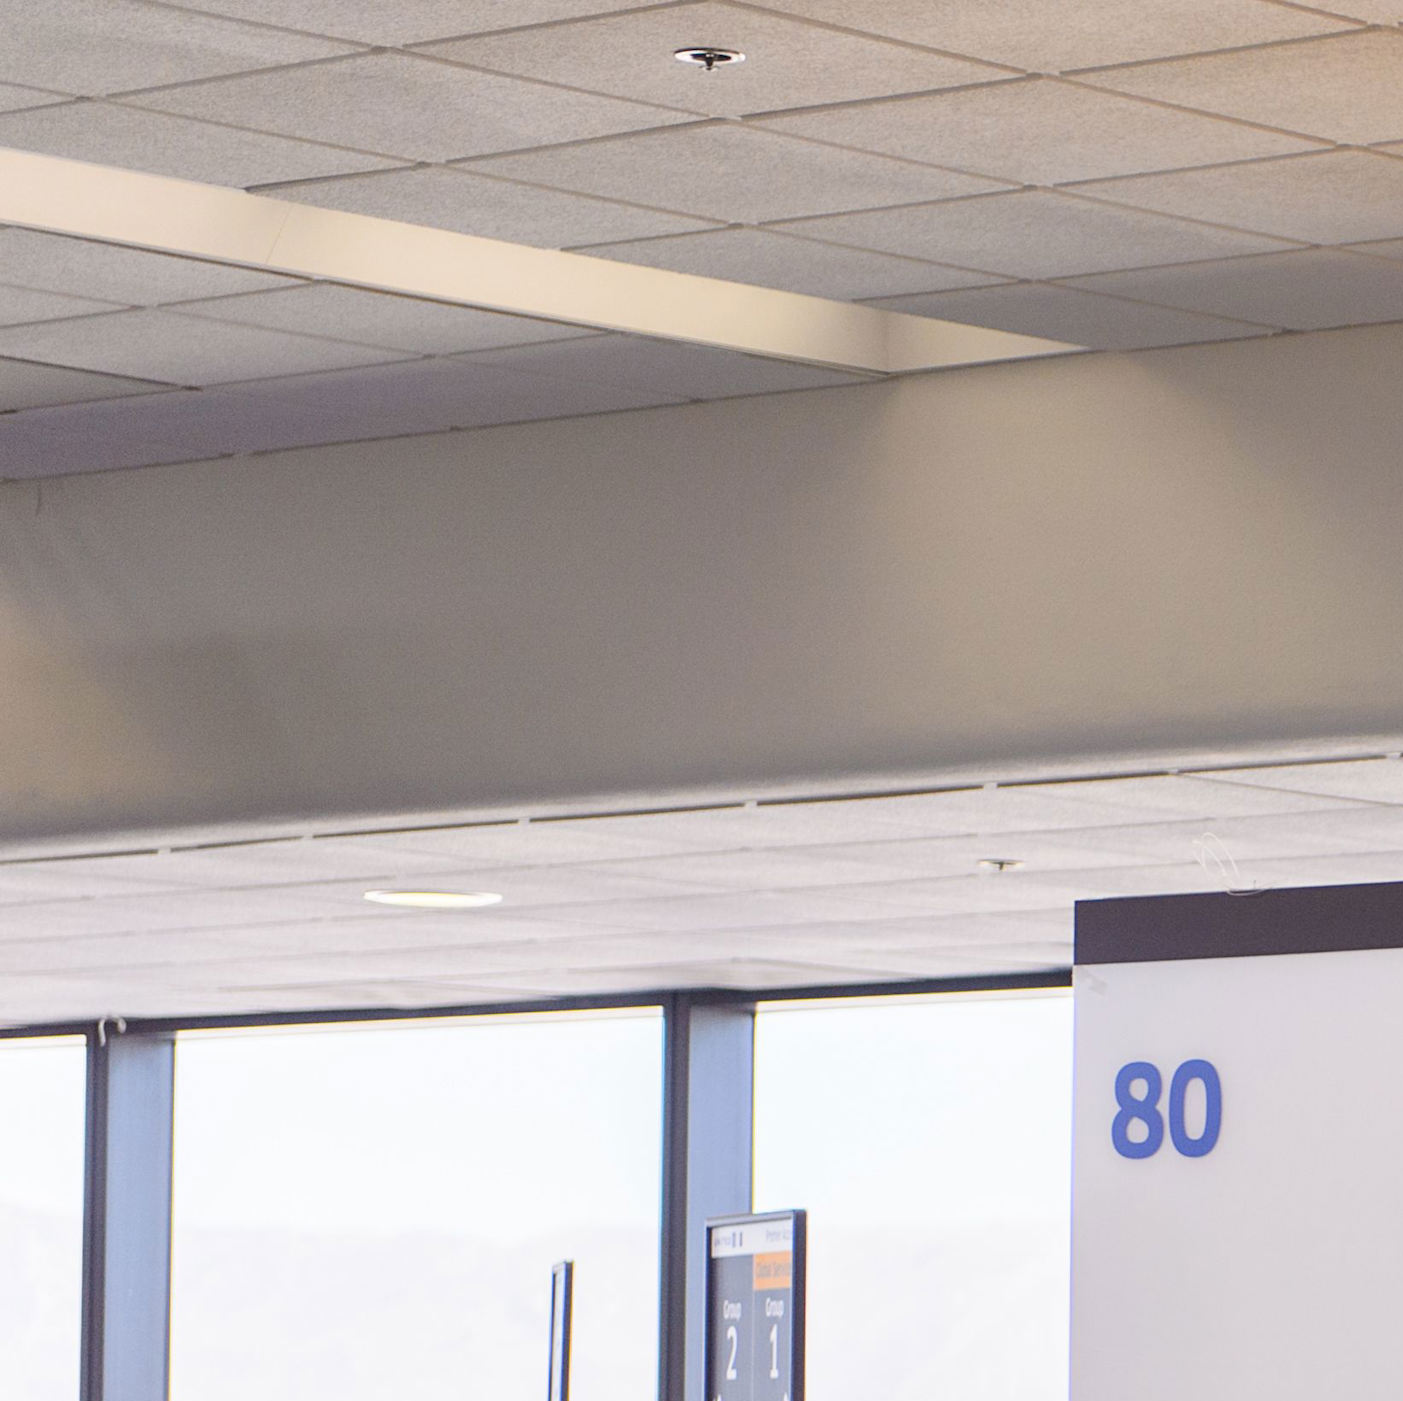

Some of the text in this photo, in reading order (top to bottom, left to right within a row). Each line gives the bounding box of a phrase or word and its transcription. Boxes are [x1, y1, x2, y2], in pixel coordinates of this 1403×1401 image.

[1111, 1058, 1222, 1159] 80
[723, 1300, 742, 1320] Group
[765, 1297, 784, 1319] Group
[726, 1326, 738, 1380] 2
[769, 1323, 779, 1379] 1
